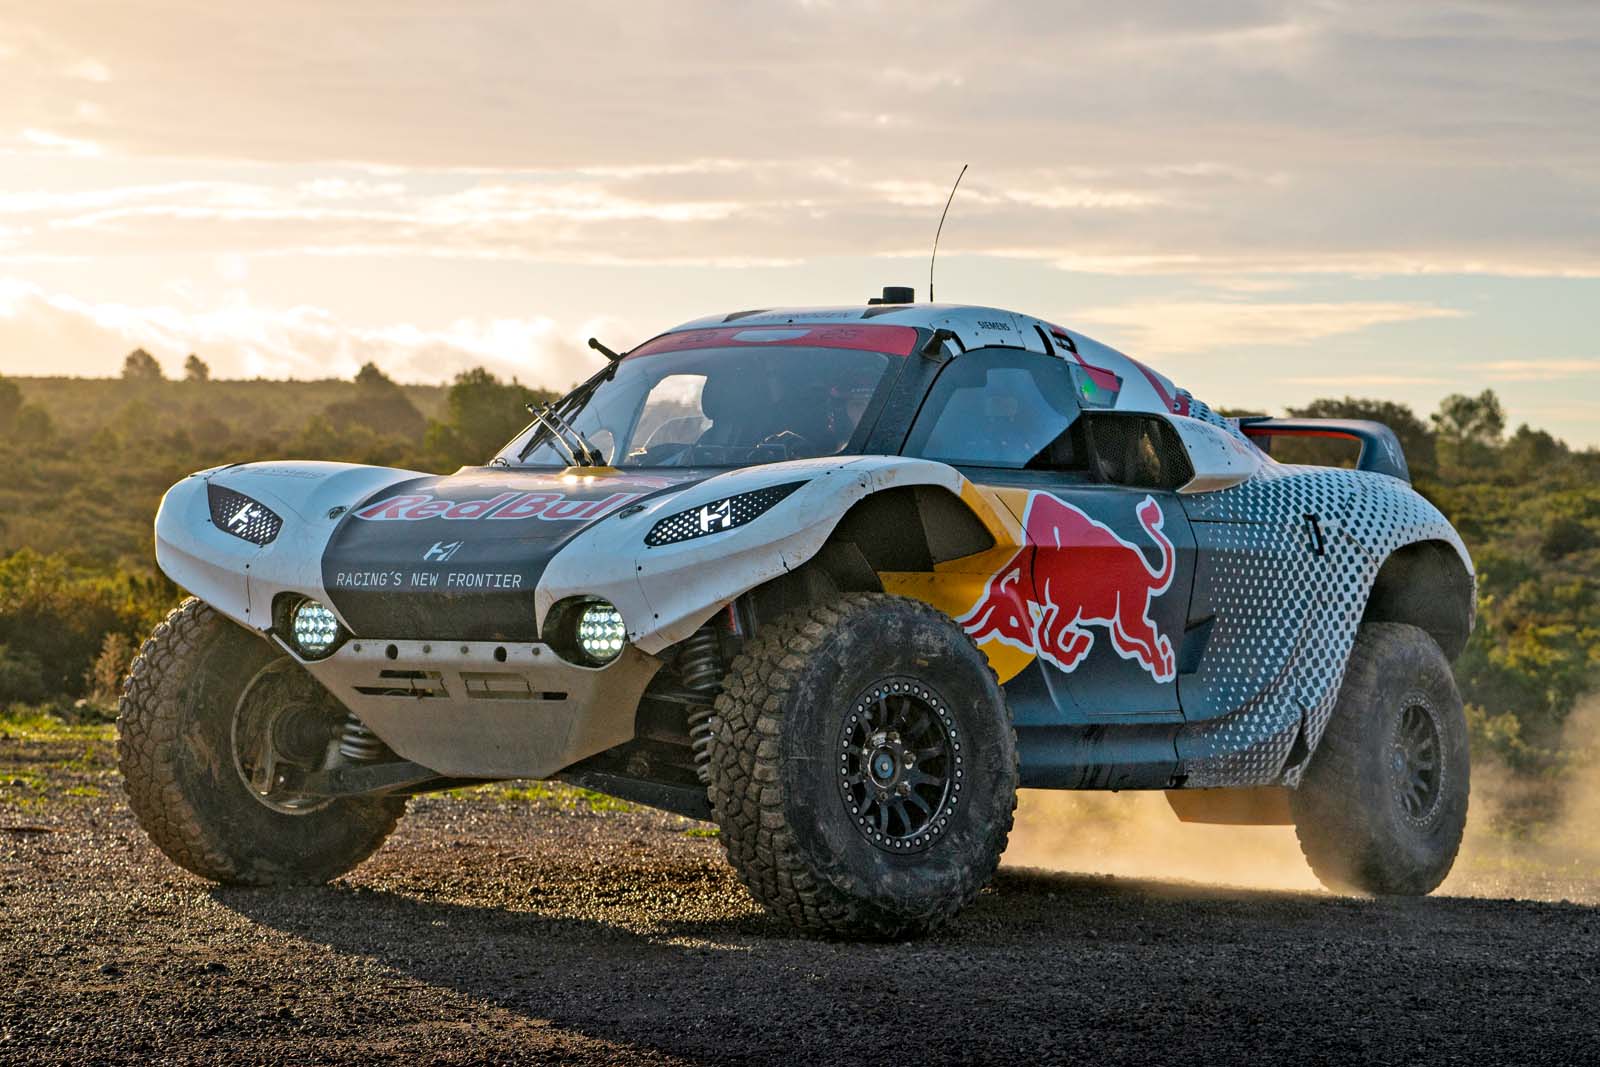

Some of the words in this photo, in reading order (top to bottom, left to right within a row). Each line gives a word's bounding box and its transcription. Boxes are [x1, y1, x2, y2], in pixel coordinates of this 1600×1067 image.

[977, 320, 1010, 331] SIEMENS
[352, 492, 526, 521] Red
[411, 572, 440, 587] NEW
[447, 573, 522, 589] FRONTIER
